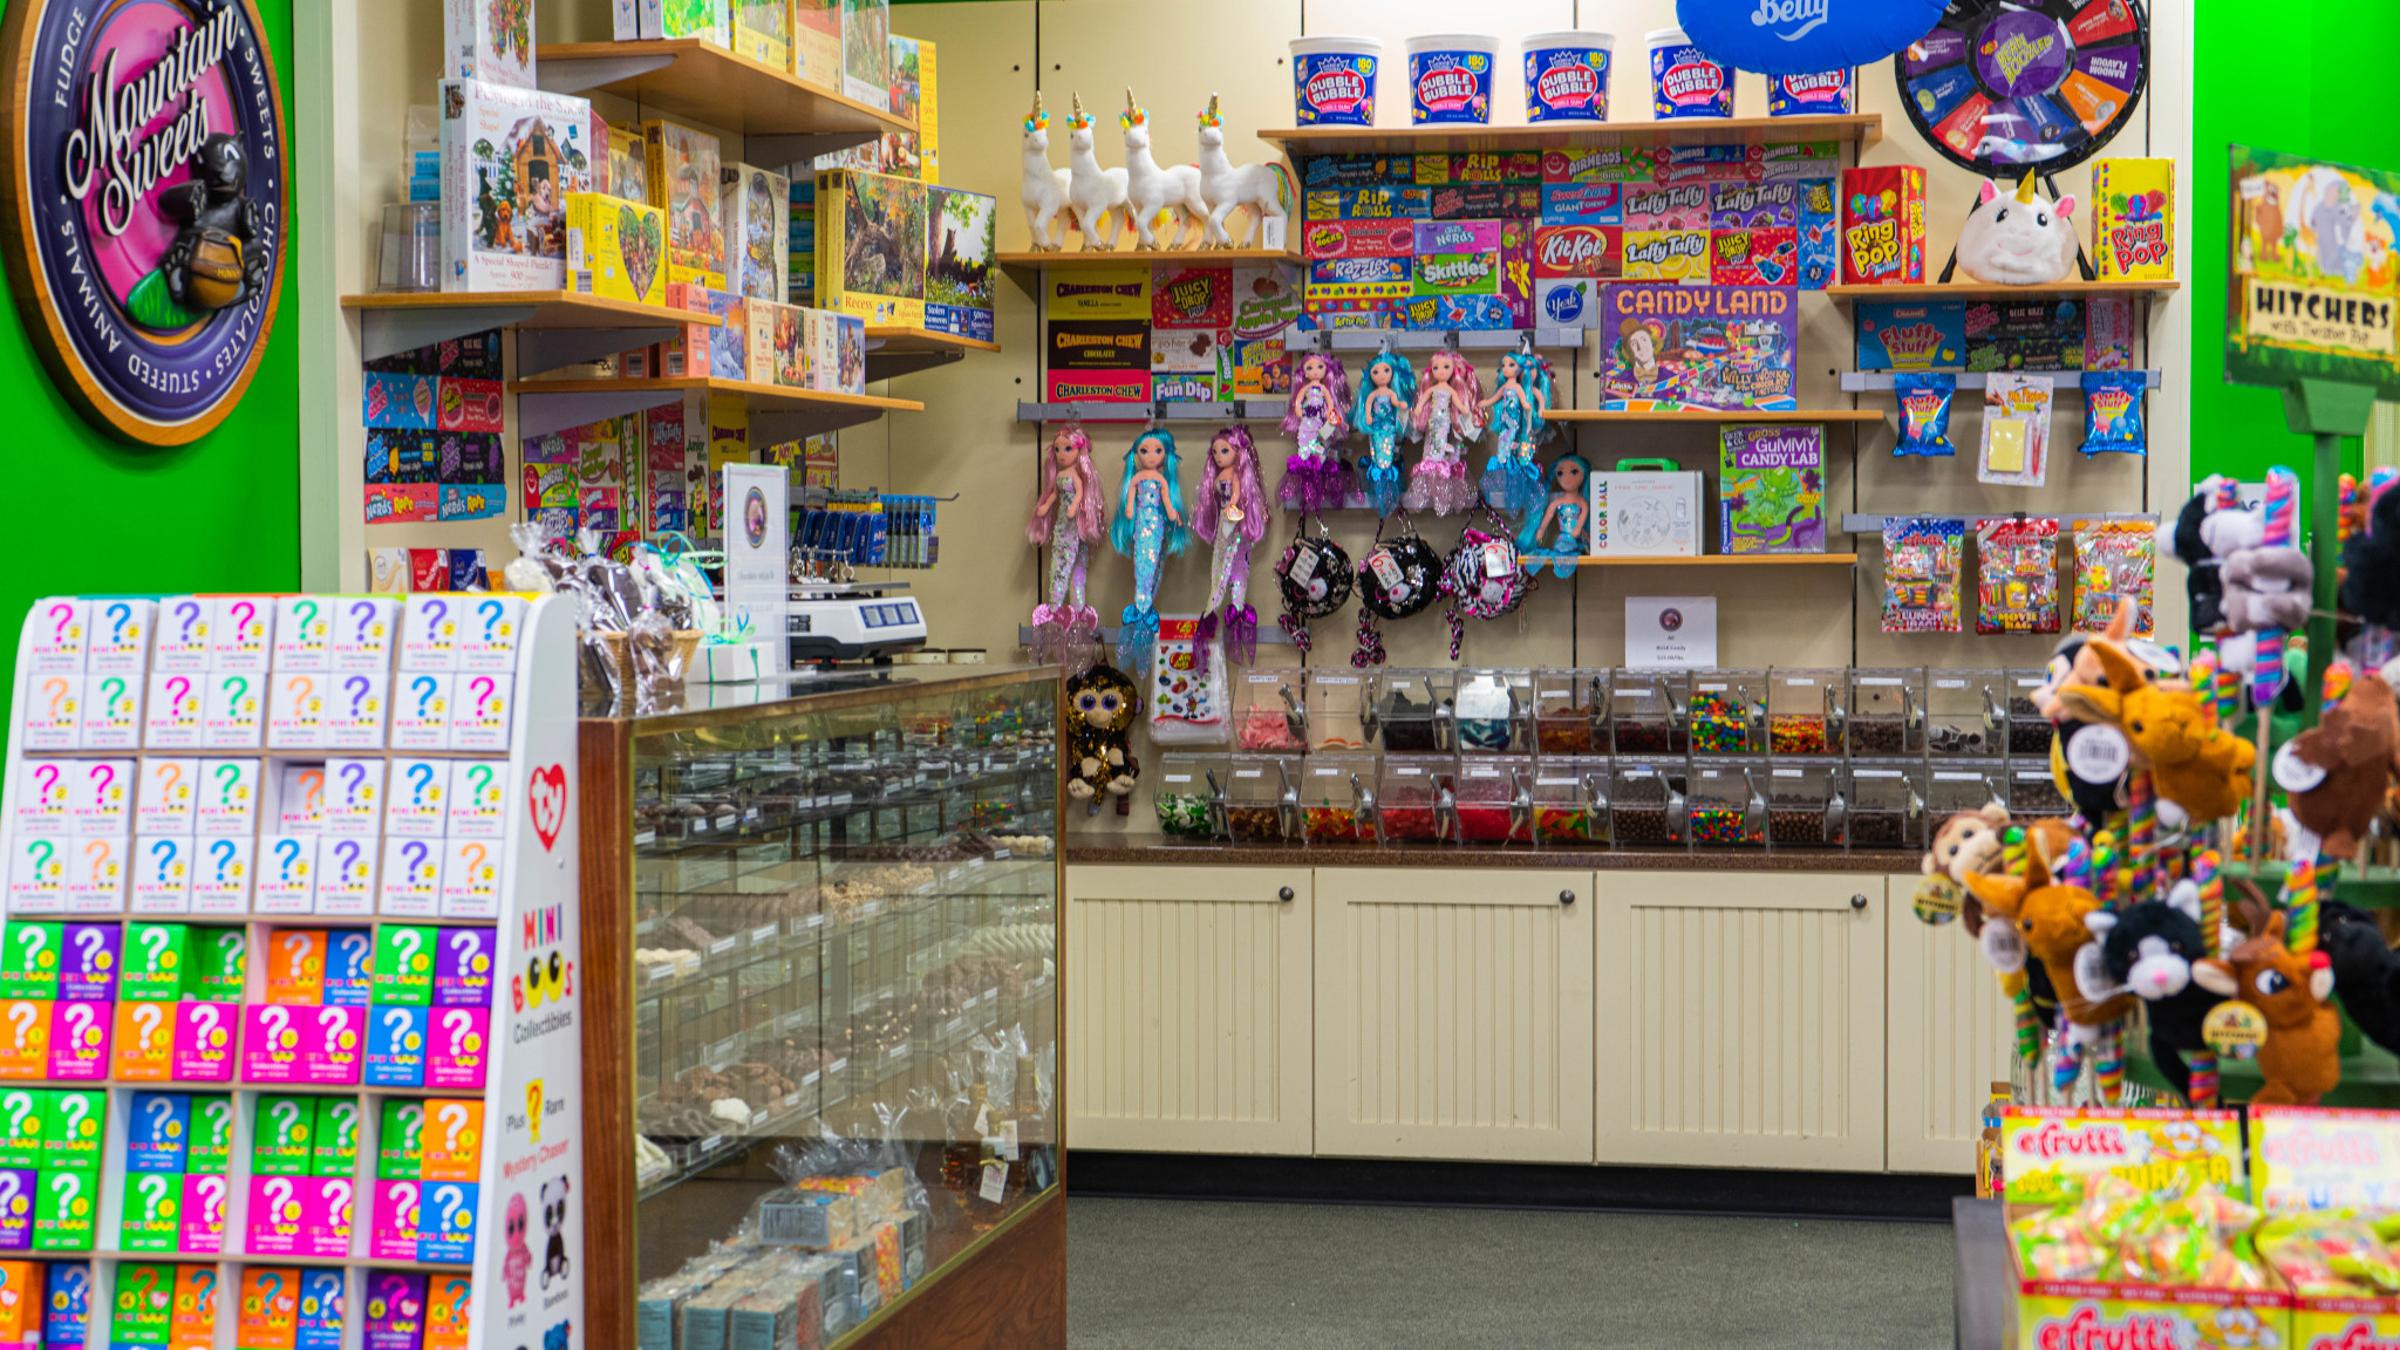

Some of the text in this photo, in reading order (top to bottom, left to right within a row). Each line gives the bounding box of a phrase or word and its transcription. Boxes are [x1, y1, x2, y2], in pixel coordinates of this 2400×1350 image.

[56, 7, 87, 109] FUDGE
[1309, 76, 1360, 92] DUBBLE
[1421, 74, 1470, 91] DUBBLE
[1541, 71, 1590, 89] DUBBLE
[1666, 68, 1716, 86] DUBBLE
[1312, 87, 1361, 104] BUBBLE
[1424, 85, 1472, 102] BUBBLE
[1544, 82, 1592, 100] BUBBLE
[1669, 79, 1718, 97] BUBBLE
[66, 3, 239, 200] Mountain
[243, 48, 275, 160] SWEETS
[1669, 147, 1705, 163] AIRHEADS
[1762, 145, 1799, 160] AIRHEADS
[102, 88, 210, 237] Sweets
[1568, 152, 1623, 175] AIRHEADS
[1762, 162, 1800, 179] AIRHEADS
[1669, 164, 1705, 181] AIRHEADS
[1627, 185, 1705, 216] Laffy Taffy
[1715, 183, 1793, 212] Laffy Taffy
[1555, 202, 1583, 213] GIANT
[1312, 229, 1328, 241] POP
[1316, 231, 1342, 248] ROCKS
[1717, 234, 1750, 252] JUICY
[1846, 220, 1896, 249] Ring
[2111, 221, 2163, 250] Ring
[1627, 234, 1706, 264] Laffy Taffy
[1724, 243, 1750, 259] DROP
[1424, 260, 1489, 282] Skittles
[1056, 283, 1143, 298] CHARLESTON CHEW
[1172, 277, 1212, 302] JUICY
[61, 220, 200, 395] STUFFED ANIMALS
[845, 296, 873, 311] Recess
[1180, 292, 1207, 309] DROP
[1409, 298, 1437, 314] JUICY
[1547, 289, 1578, 320] York
[2256, 286, 2389, 330] HITCHERS
[1056, 332, 1113, 349] CHARLESTON
[1115, 333, 1143, 349] CHEW
[1879, 323, 1945, 347] Fluffy
[1892, 337, 1935, 354] Stuff
[1056, 383, 1143, 400] CHARLESTON CHEW
[1156, 381, 1212, 402] Fun Dip
[2090, 391, 2134, 405] Fluffy
[1902, 394, 1943, 409] Fluffy
[1747, 428, 1780, 442] GROSS
[1741, 452, 1819, 466] CANDY LAB
[1901, 610, 1942, 621] LUNCH
[1997, 612, 2038, 622] MOVIE
[522, 903, 563, 950] MINI
[513, 1010, 573, 1045] Collectibles
[506, 1114, 525, 1133] Plus
[2018, 1122, 2127, 1159] efrutti
[503, 1139, 569, 1180] Mystery Chaser
